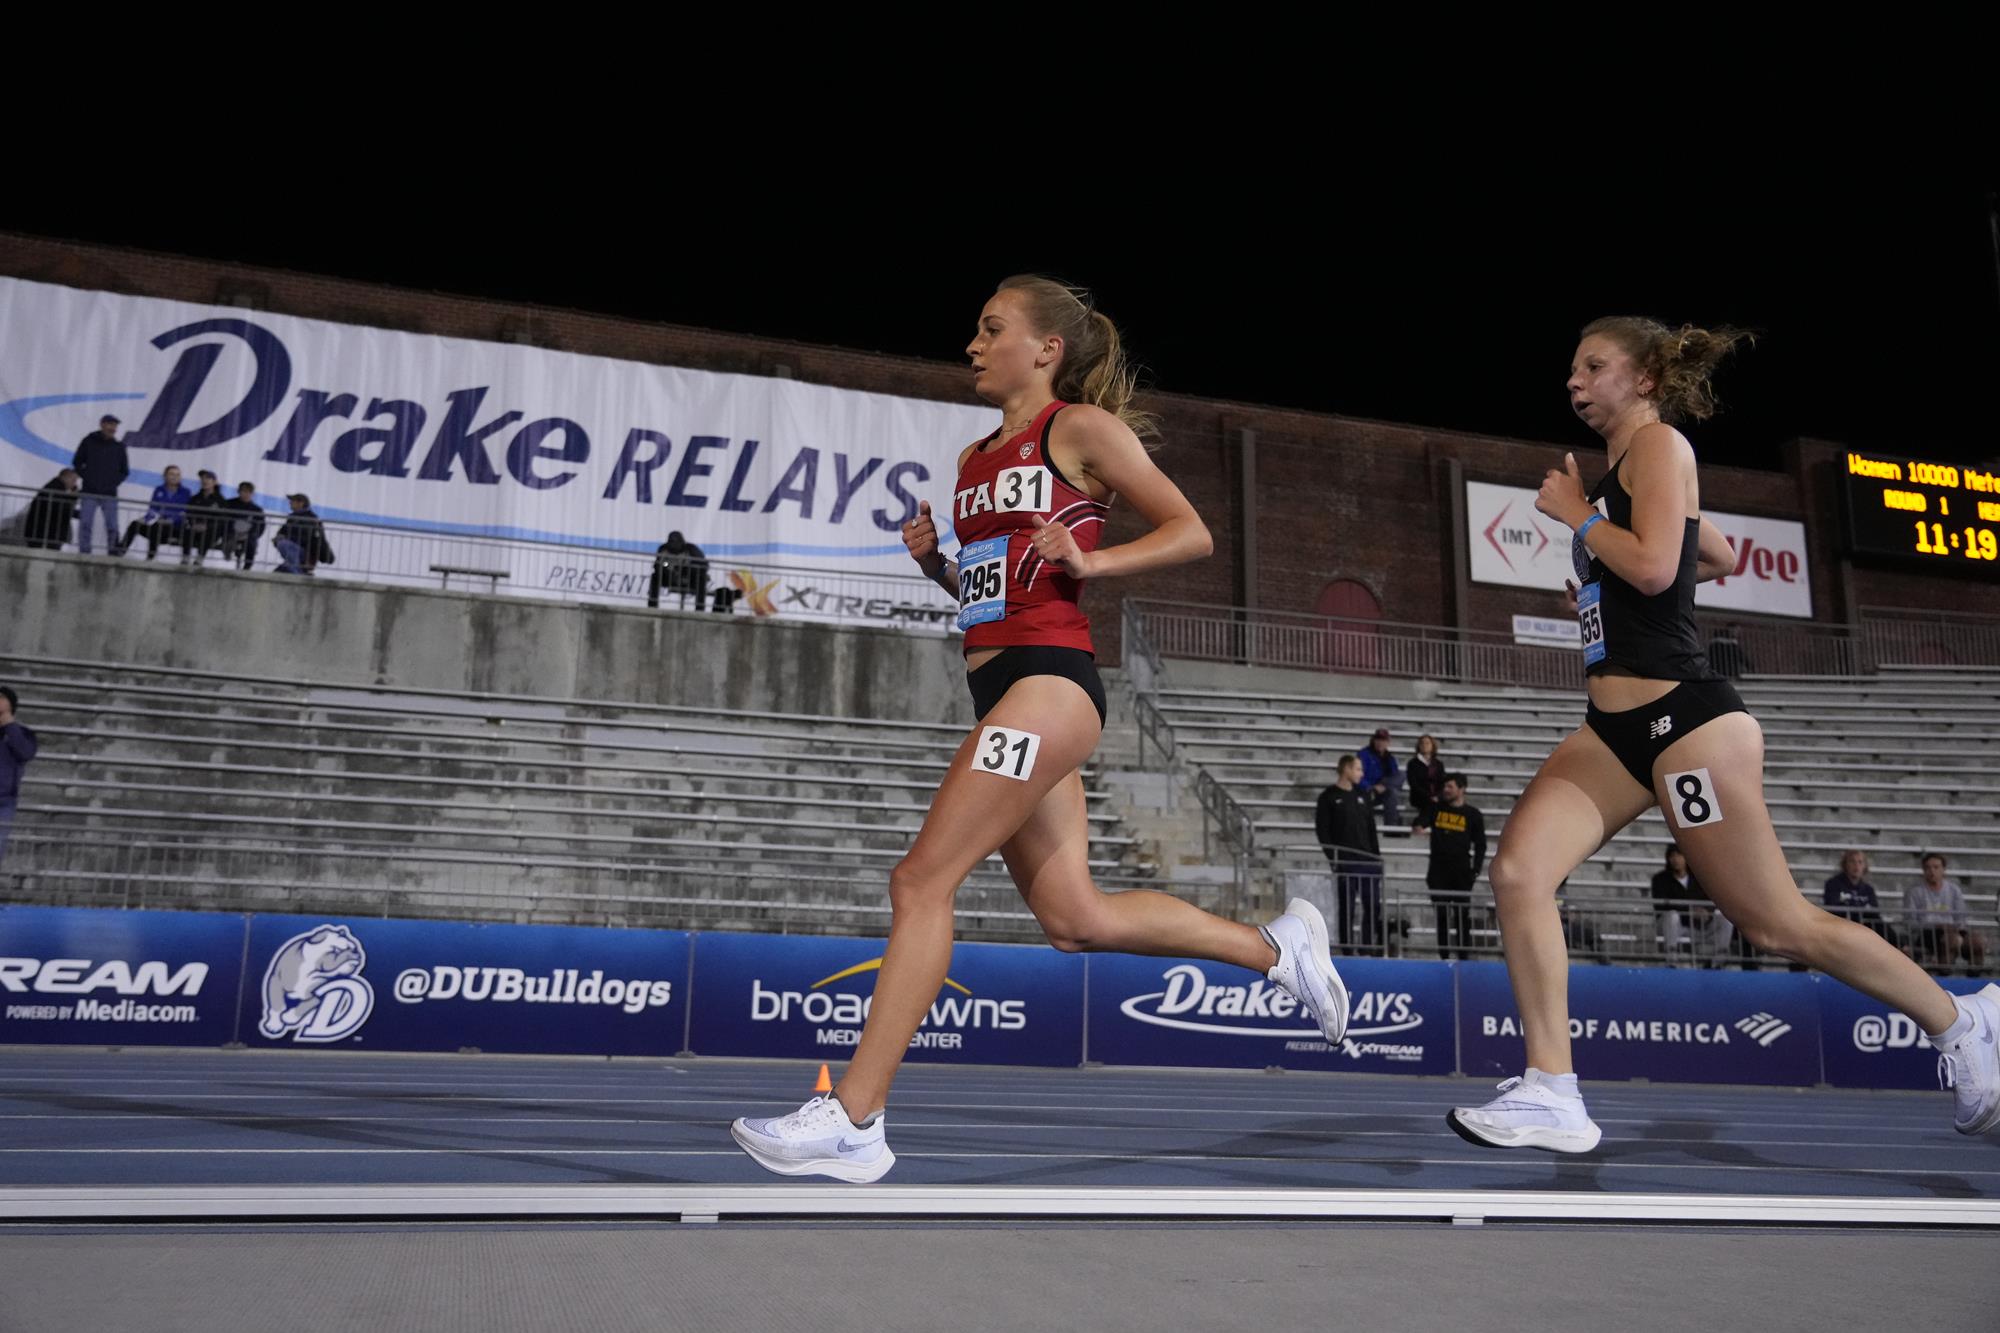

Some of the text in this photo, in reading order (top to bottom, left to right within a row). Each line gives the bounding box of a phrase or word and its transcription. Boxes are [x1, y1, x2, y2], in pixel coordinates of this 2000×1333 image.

[125, 318, 931, 532] Drake RELAYS
[1003, 470, 1043, 509] 31
[1848, 453, 1901, 480] Women
[1908, 462, 1959, 488] 10000
[954, 482, 993, 520] TA
[1940, 496, 1949, 515] 1
[1502, 528, 1533, 546] IMT
[1915, 521, 1998, 560] 11:19
[1717, 536, 1798, 584] Vee
[546, 566, 653, 597] PRESENT
[960, 561, 1001, 610] 295
[1580, 607, 1601, 645] 55
[983, 731, 1030, 776] 31
[1676, 774, 1711, 824] 8
[394, 966, 671, 1014] @DUBulldogs
[752, 979, 1026, 1030] broawns
[1157, 965, 1297, 1018] Drake
[6, 999, 197, 1023] POWERED BY Mediacom
[1482, 1016, 1730, 1044] BA OF AMERICA
[816, 1028, 963, 1049] MEDI ENTER
[1285, 1041, 1327, 1052] PRESENTED
[1360, 1043, 1423, 1055] XTREAM
